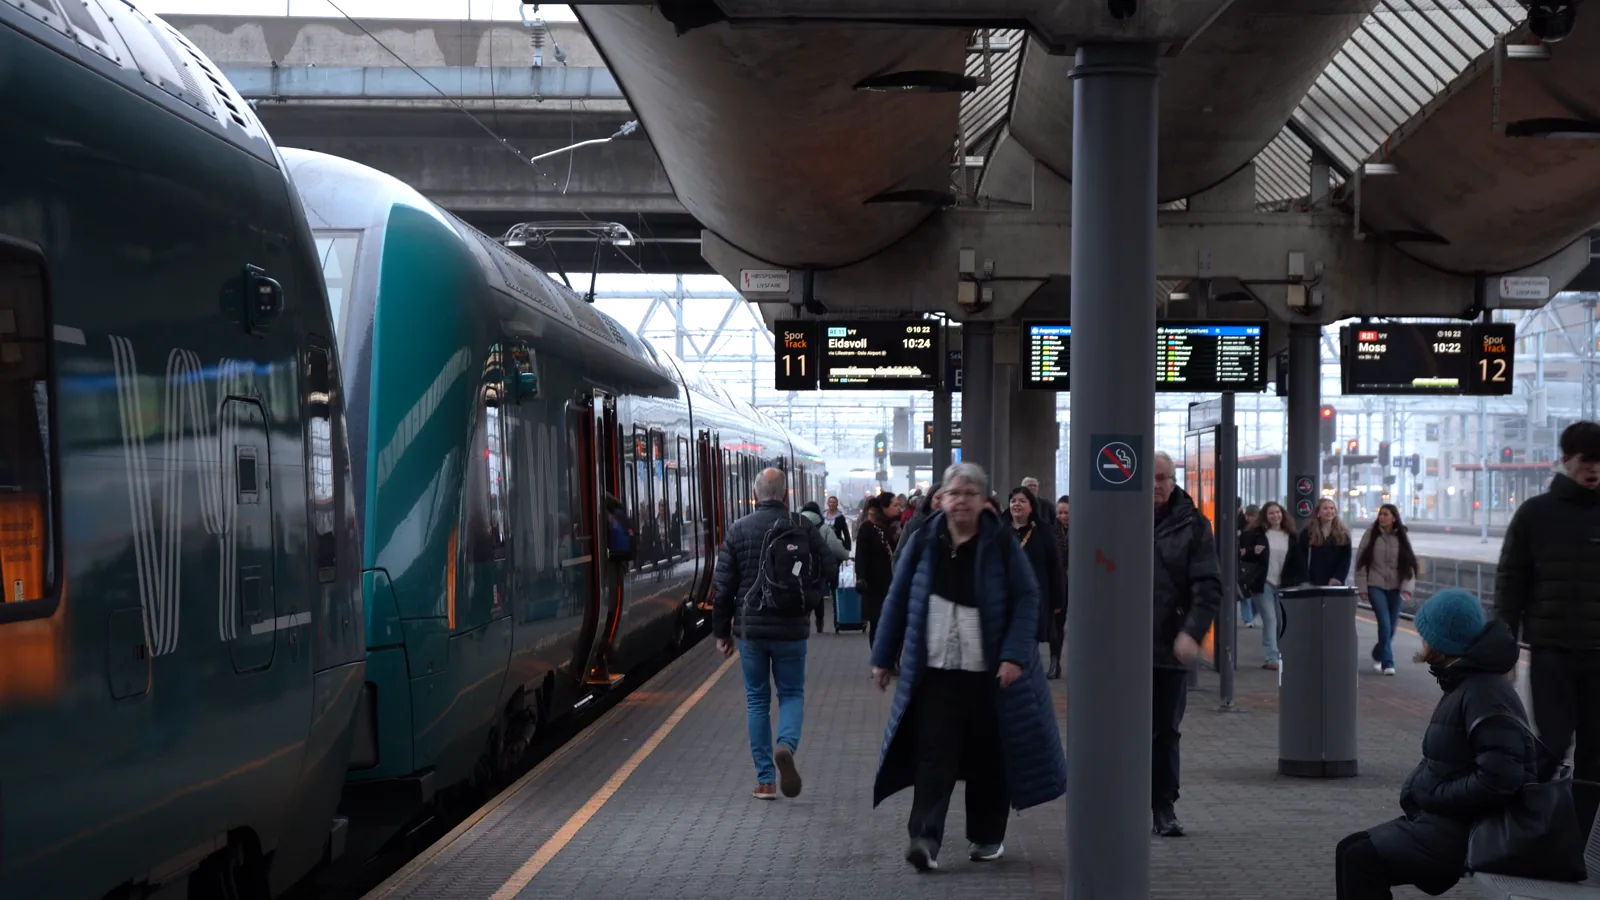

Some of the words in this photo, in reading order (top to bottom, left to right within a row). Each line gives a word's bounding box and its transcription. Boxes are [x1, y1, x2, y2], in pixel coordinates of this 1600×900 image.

[784, 331, 804, 341] Spor
[1483, 335, 1503, 345] Spor
[785, 340, 807, 348] Track
[828, 338, 867, 348] Eidsvoll
[902, 338, 931, 348] 10:24
[1358, 342, 1387, 352] Moss
[1433, 342, 1461, 352] 10:22
[1484, 344, 1506, 352] Track
[782, 354, 806, 377] 11
[1479, 358, 1506, 381] 12
